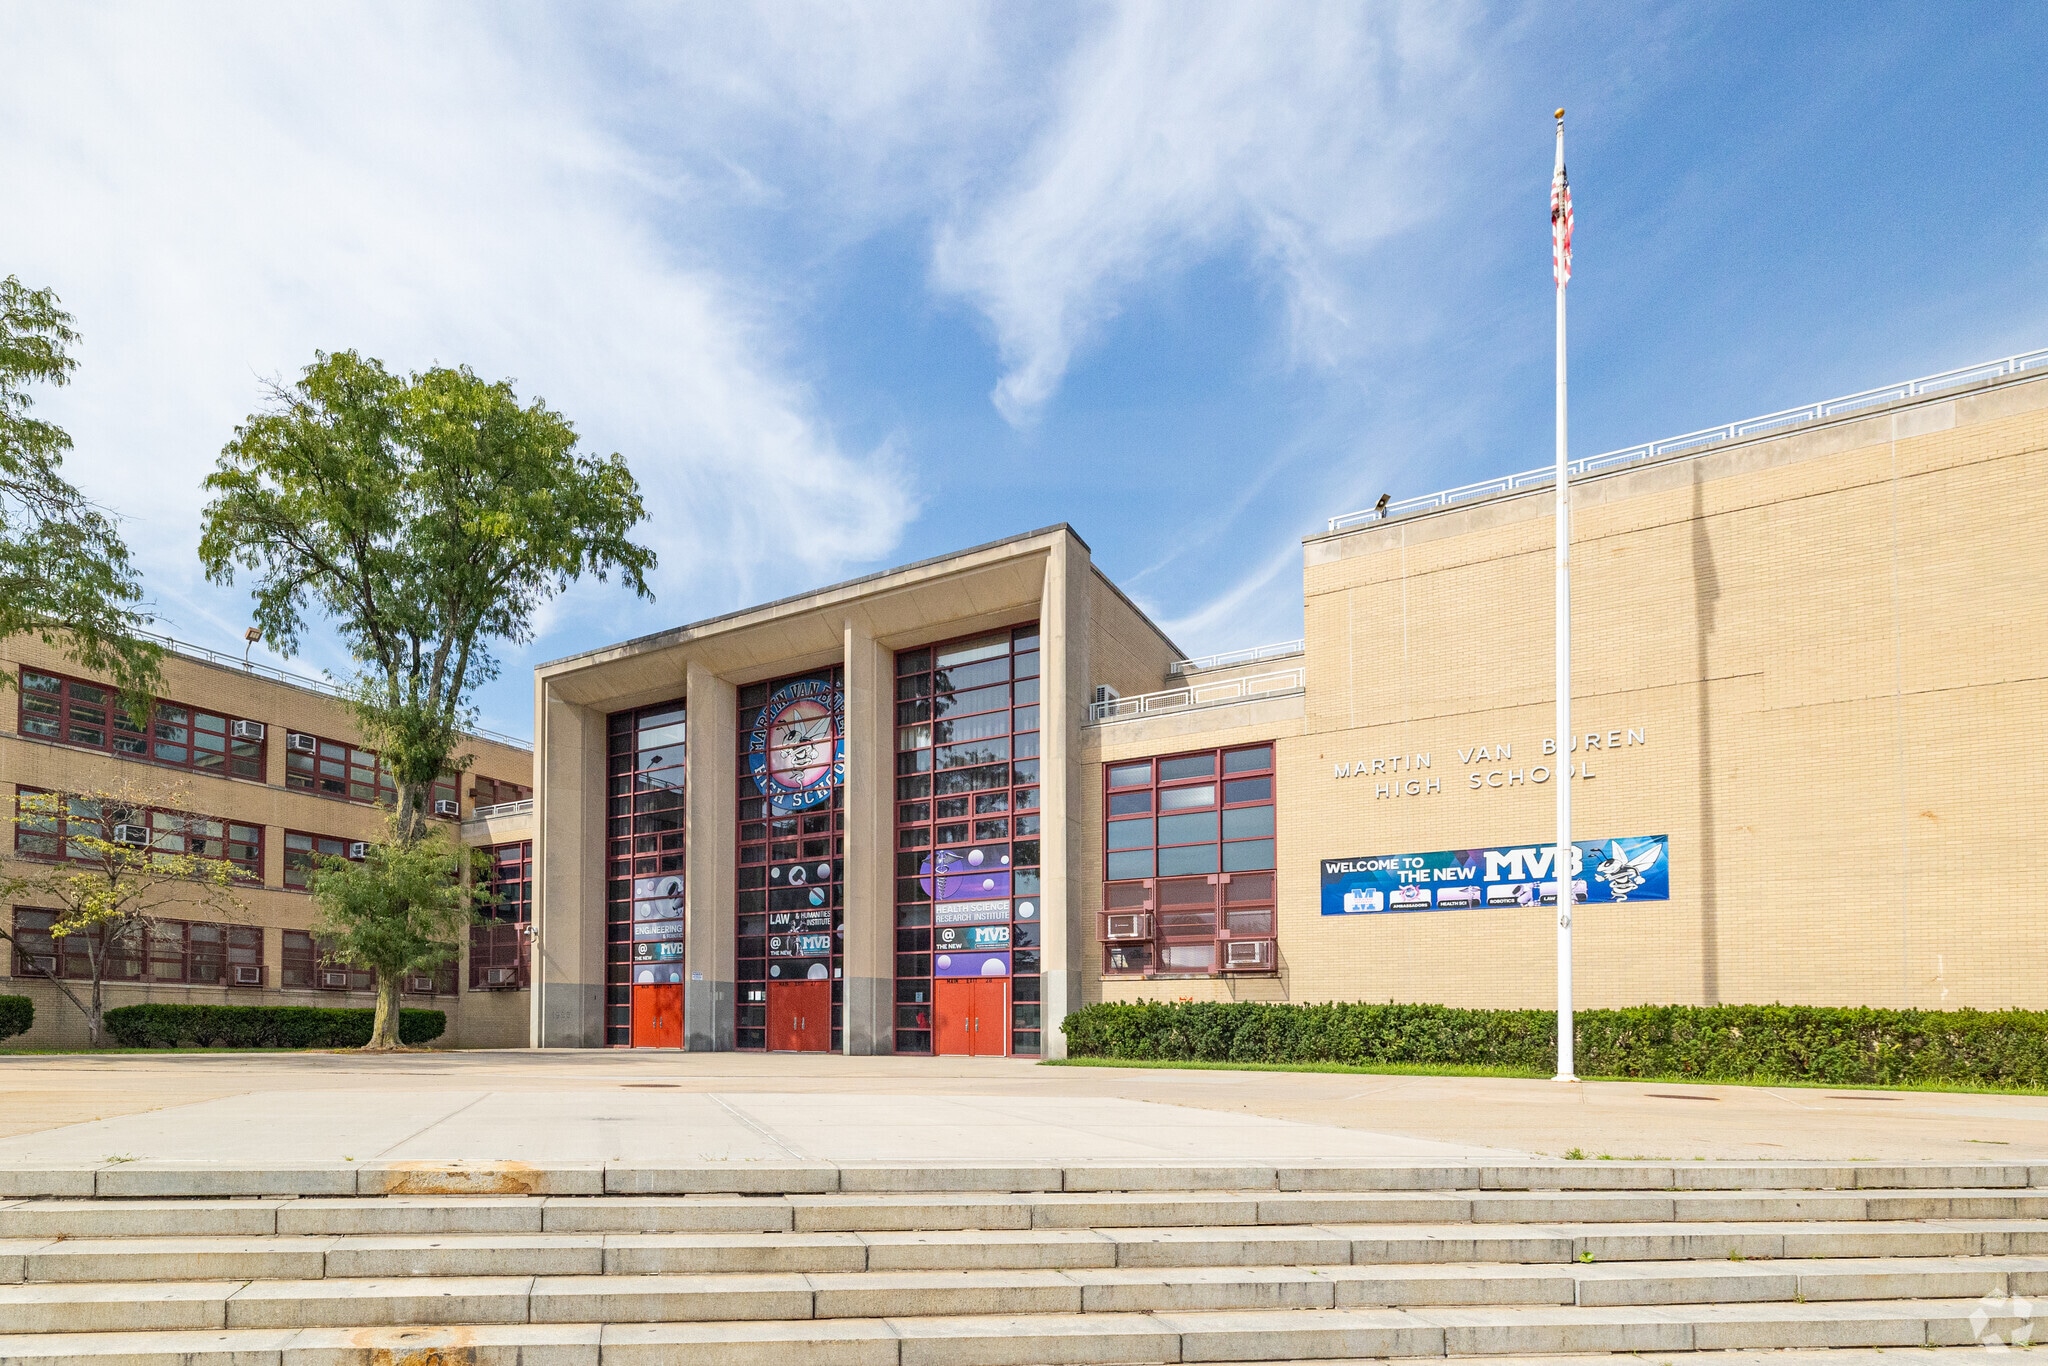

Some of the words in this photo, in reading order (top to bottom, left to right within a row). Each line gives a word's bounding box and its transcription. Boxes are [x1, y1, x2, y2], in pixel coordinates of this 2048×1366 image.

[749, 690, 790, 754] MARTIN
[790, 682, 820, 699] VAN
[1334, 752, 1431, 779] MARTIN
[1457, 743, 1512, 764] VAN
[754, 763, 787, 804] HIGH
[1375, 776, 1441, 800] HIGH
[1325, 858, 1399, 874] WELCOME
[1402, 857, 1424, 869] TO
[1483, 845, 1583, 882] MVB
[1397, 869, 1431, 884] THE
[1433, 866, 1477, 881] NEW
[935, 904, 969, 914] HEALTH
[971, 902, 1009, 912] SCIENCE
[770, 913, 790, 925] LAW
[807, 918, 830, 926] INSTITUTE
[935, 913, 972, 923] RESEARCH
[974, 912, 1010, 921] INSTITUTE
[635, 925, 682, 934] ENGINEERING
[942, 928, 955, 942] @
[975, 927, 1010, 942] MVB
[638, 943, 647, 955] @
[661, 943, 683, 954] MVB
[770, 936, 781, 949] @
[803, 936, 830, 949] MVB
